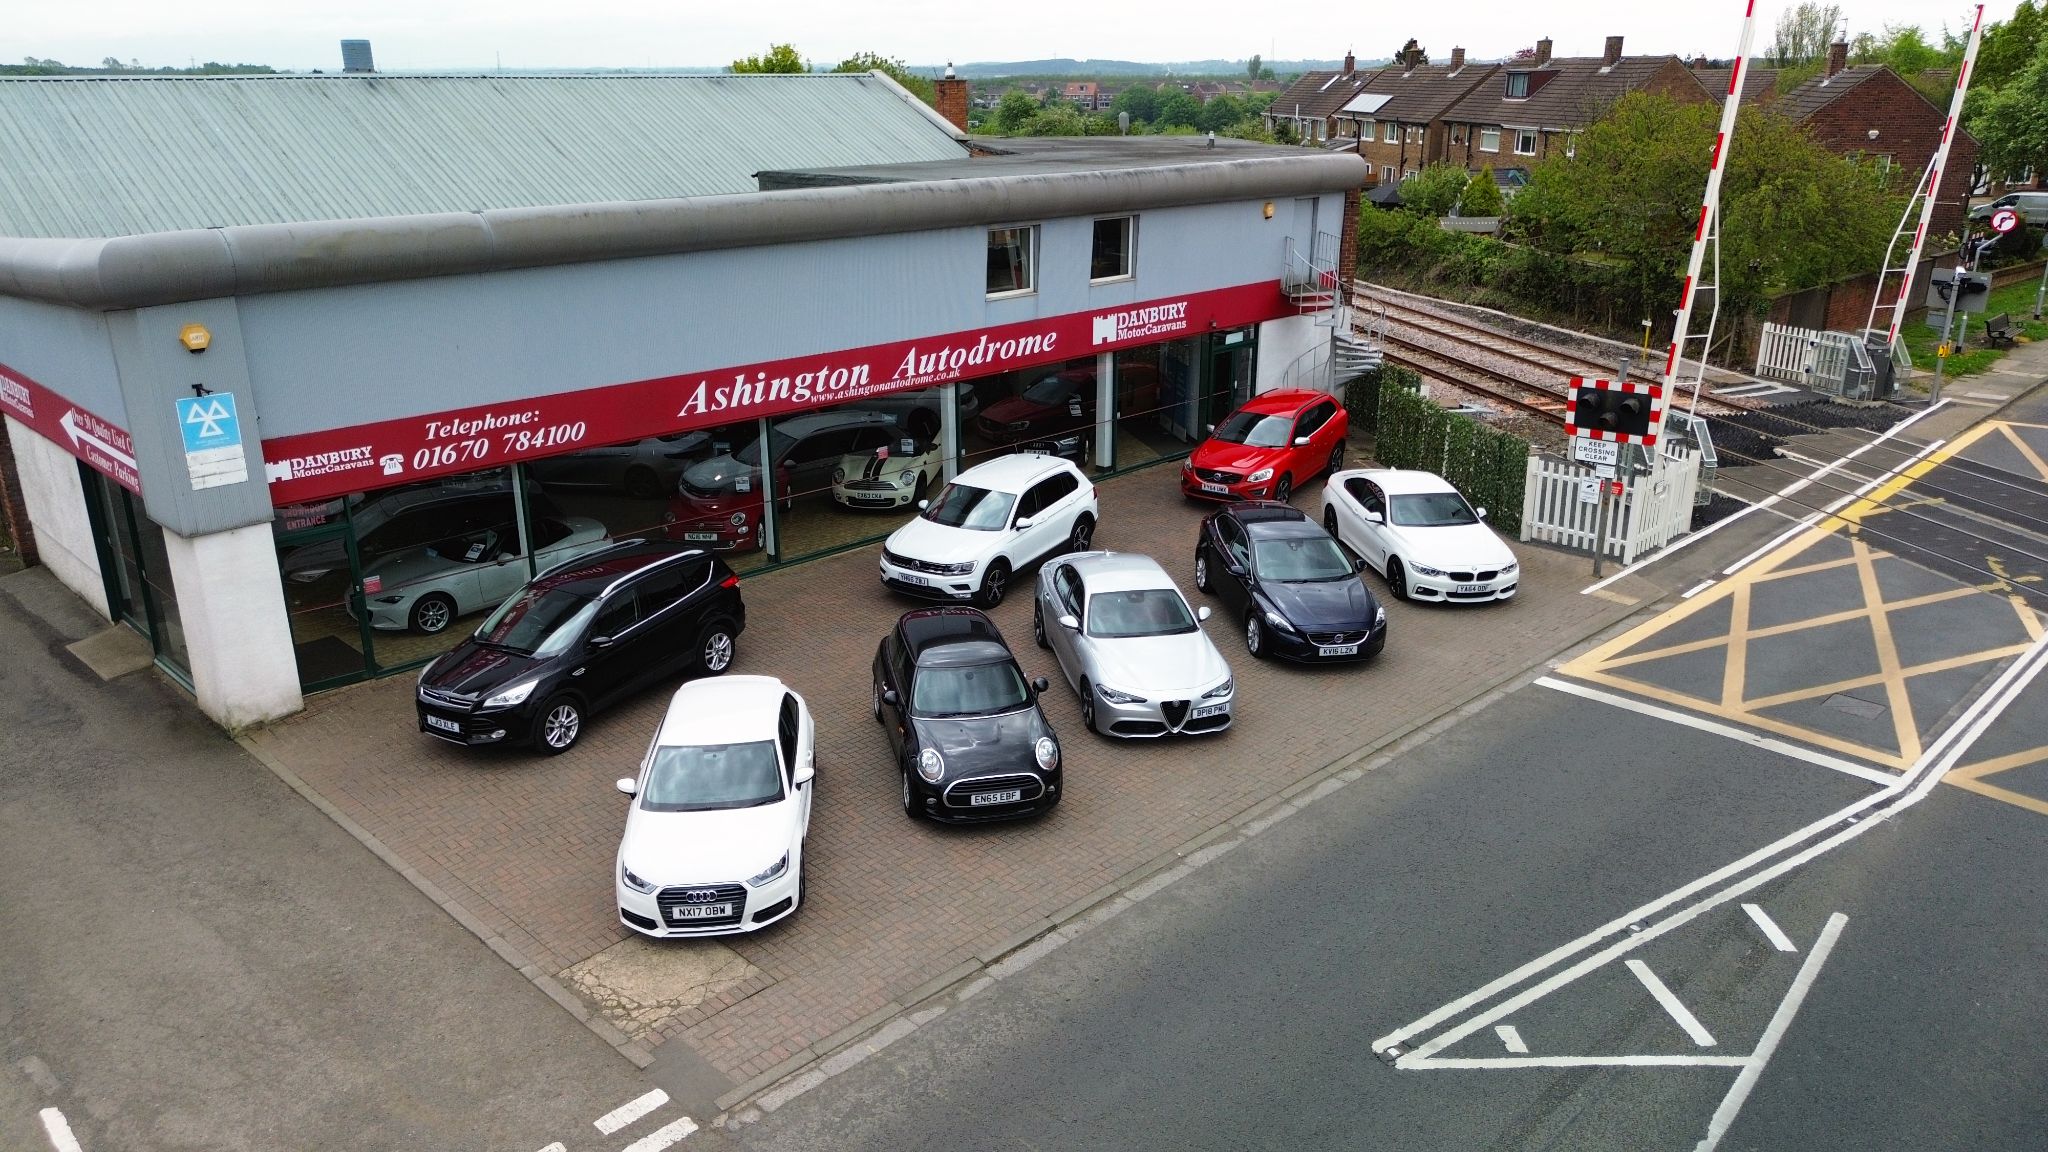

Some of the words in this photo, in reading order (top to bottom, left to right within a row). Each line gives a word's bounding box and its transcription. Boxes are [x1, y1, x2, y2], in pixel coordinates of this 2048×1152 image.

[1118, 302, 1187, 329] DANBURY
[1118, 320, 1187, 341] MotorCaravans
[677, 365, 869, 417] Ashington
[893, 332, 1057, 380] Autodrome
[811, 369, 960, 403] www.ashingtonautodrome.co.uk
[425, 409, 540, 441] Telephone:
[413, 439, 489, 470] 01670
[503, 421, 586, 454] 784100
[1578, 446, 1616, 457] CROSSING
[291, 446, 372, 471] DANBURY
[1585, 453, 1608, 462] CLEAR
[293, 459, 374, 479] MotorCaravans
[287, 515, 326, 530] ENTRANCE
[1197, 707, 1213, 717] BP18
[1214, 704, 1227, 714] PMU
[974, 794, 998, 804] EN65
[1000, 791, 1017, 801] EBF
[679, 907, 703, 917] NX17
[705, 905, 726, 916] OBW
